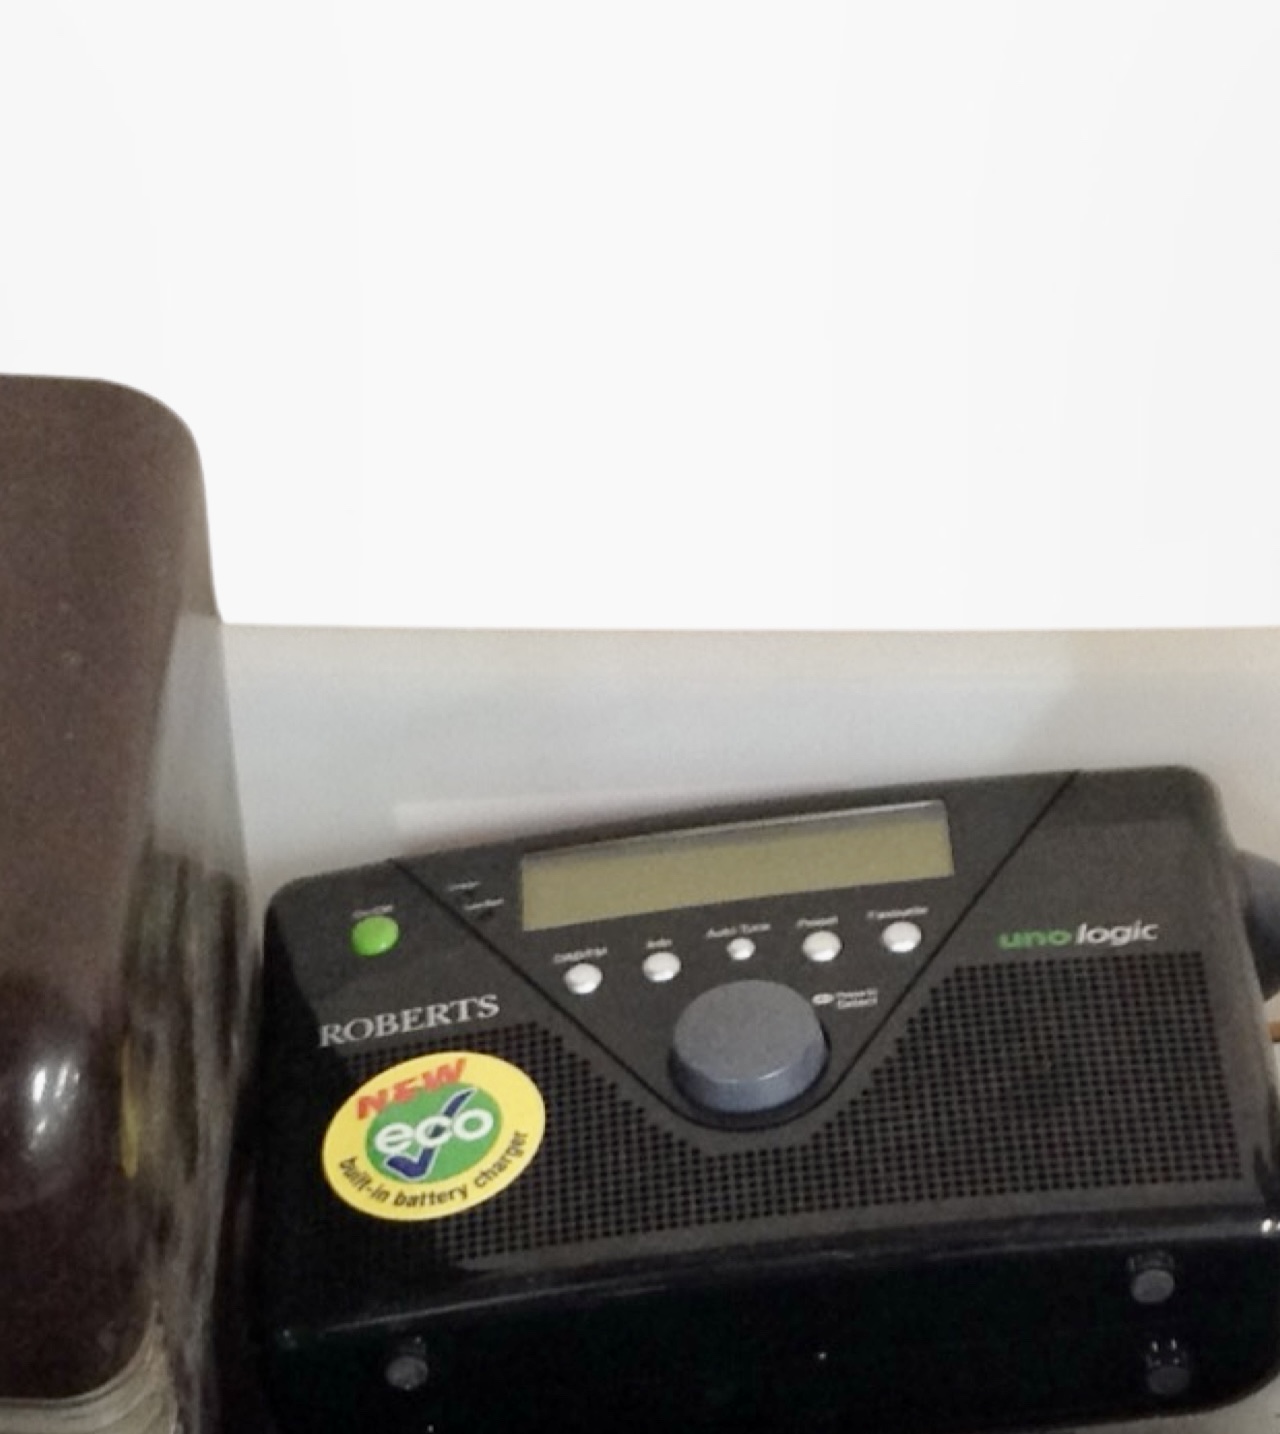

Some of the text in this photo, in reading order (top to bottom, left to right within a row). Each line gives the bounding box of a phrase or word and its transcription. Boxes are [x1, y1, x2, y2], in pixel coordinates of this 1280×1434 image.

[320, 994, 500, 1047] ROBERTS
[356, 1058, 467, 1120] NEW
[374, 1107, 494, 1154] eco
[338, 1130, 528, 1209] built-in battery charger
